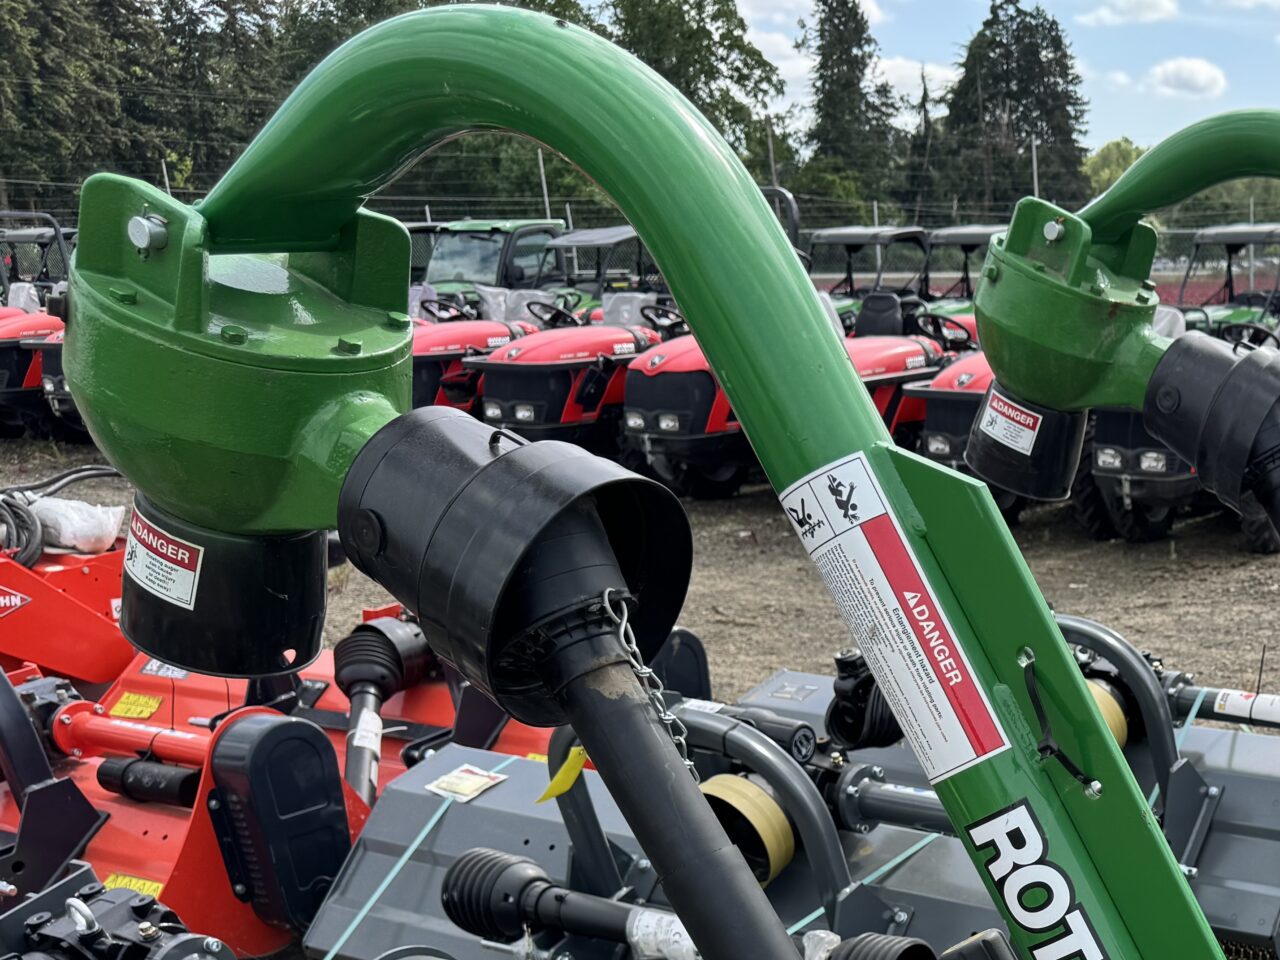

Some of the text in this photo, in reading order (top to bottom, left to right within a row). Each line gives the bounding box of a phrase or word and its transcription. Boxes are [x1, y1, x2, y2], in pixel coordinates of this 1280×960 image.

[998, 402, 1033, 427] DANGER
[136, 521, 191, 565] DANGER
[872, 585, 886, 607] prevent
[883, 607, 896, 628] serious
[893, 628, 905, 644] injury
[905, 651, 917, 668] death
[913, 667, 924, 681] from
[920, 681, 935, 703] rotating
[891, 607, 935, 684] Entanglement hazard
[911, 603, 963, 686] DANGER
